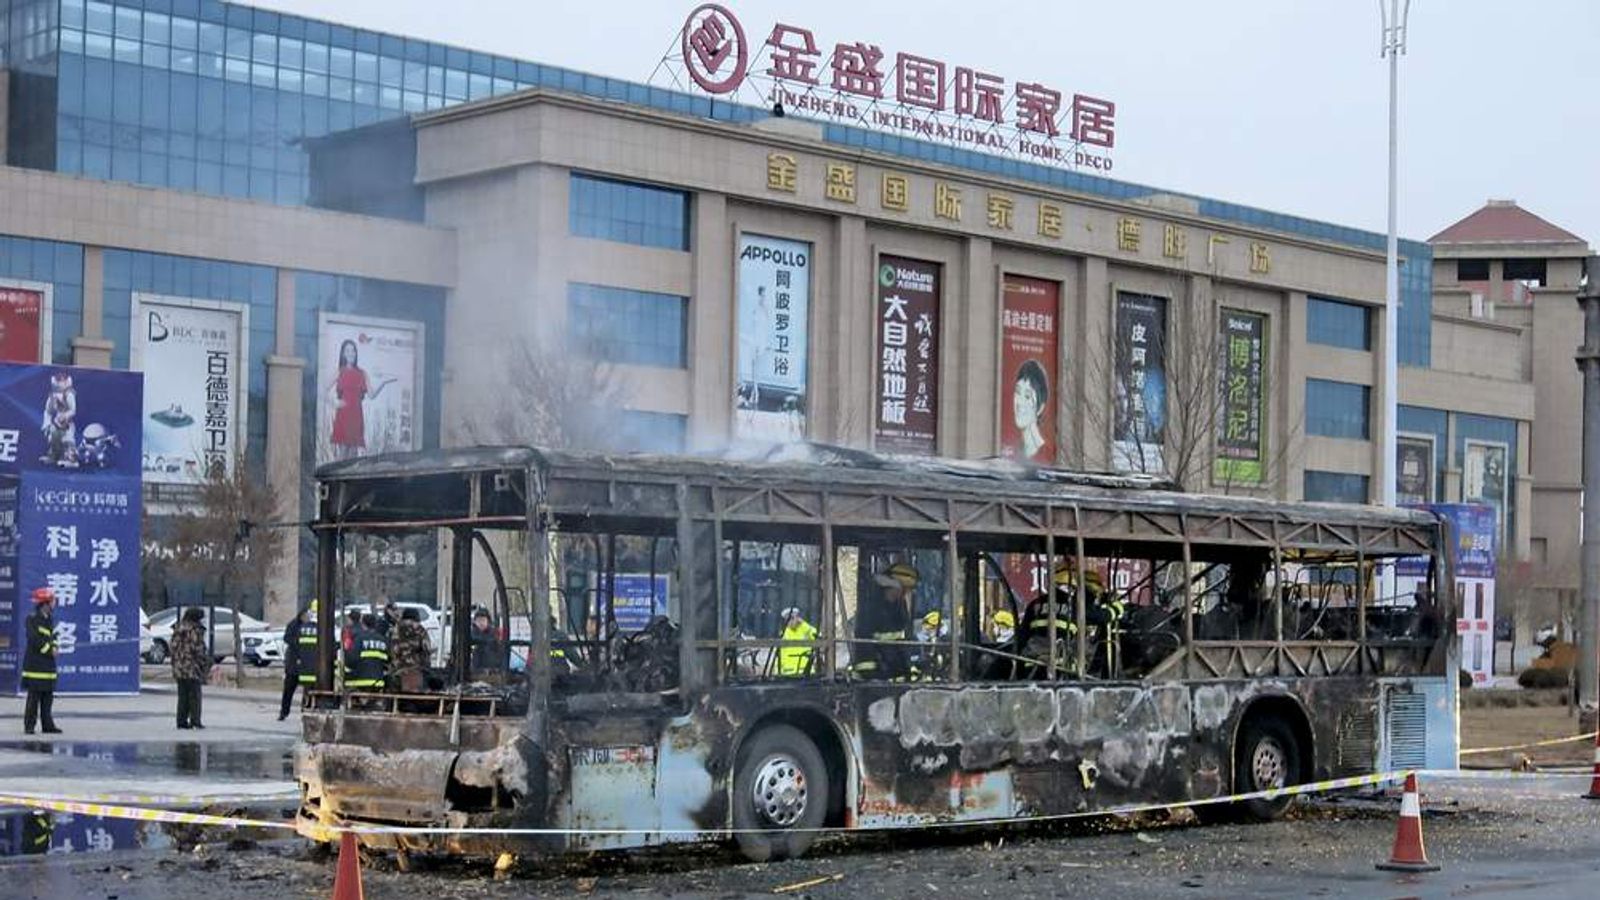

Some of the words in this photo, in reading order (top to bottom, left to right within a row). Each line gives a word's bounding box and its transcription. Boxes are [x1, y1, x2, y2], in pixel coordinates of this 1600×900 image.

[765, 23, 1117, 149] 金盛国际家居
[767, 87, 858, 119] JINSHENG
[872, 110, 1006, 150] INTERNATIONAL
[1019, 140, 1063, 163] HOME
[1075, 152, 1113, 171] DECO
[740, 244, 806, 268] APPOLLO
[897, 267, 934, 284] Nature
[774, 269, 791, 376] 阿波罗卫浴
[881, 294, 908, 424] 大自然地板
[204, 350, 229, 480] 百德嘉卫浴
[90, 537, 120, 643] 净水器
